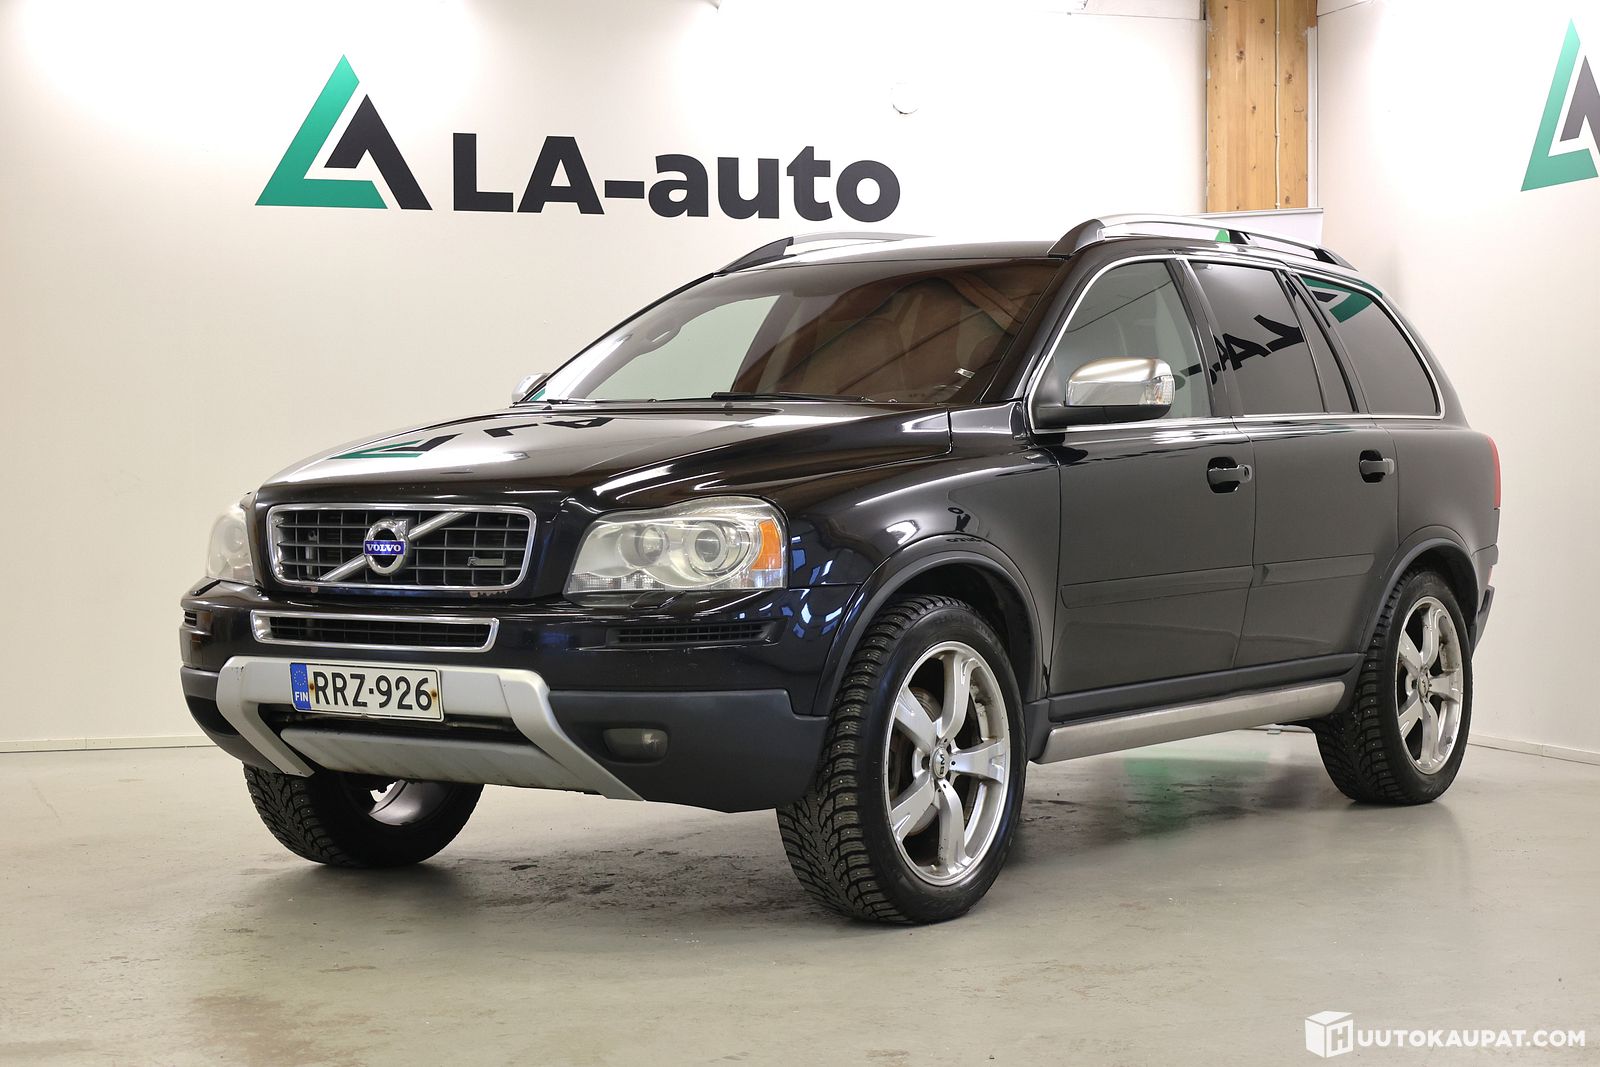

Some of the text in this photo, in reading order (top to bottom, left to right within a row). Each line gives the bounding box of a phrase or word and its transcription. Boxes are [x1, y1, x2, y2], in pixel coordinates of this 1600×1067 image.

[452, 132, 901, 223] LA-auto
[366, 543, 402, 552] VOLVO
[294, 691, 309, 702] FIN
[312, 671, 432, 711] RRZ-926
